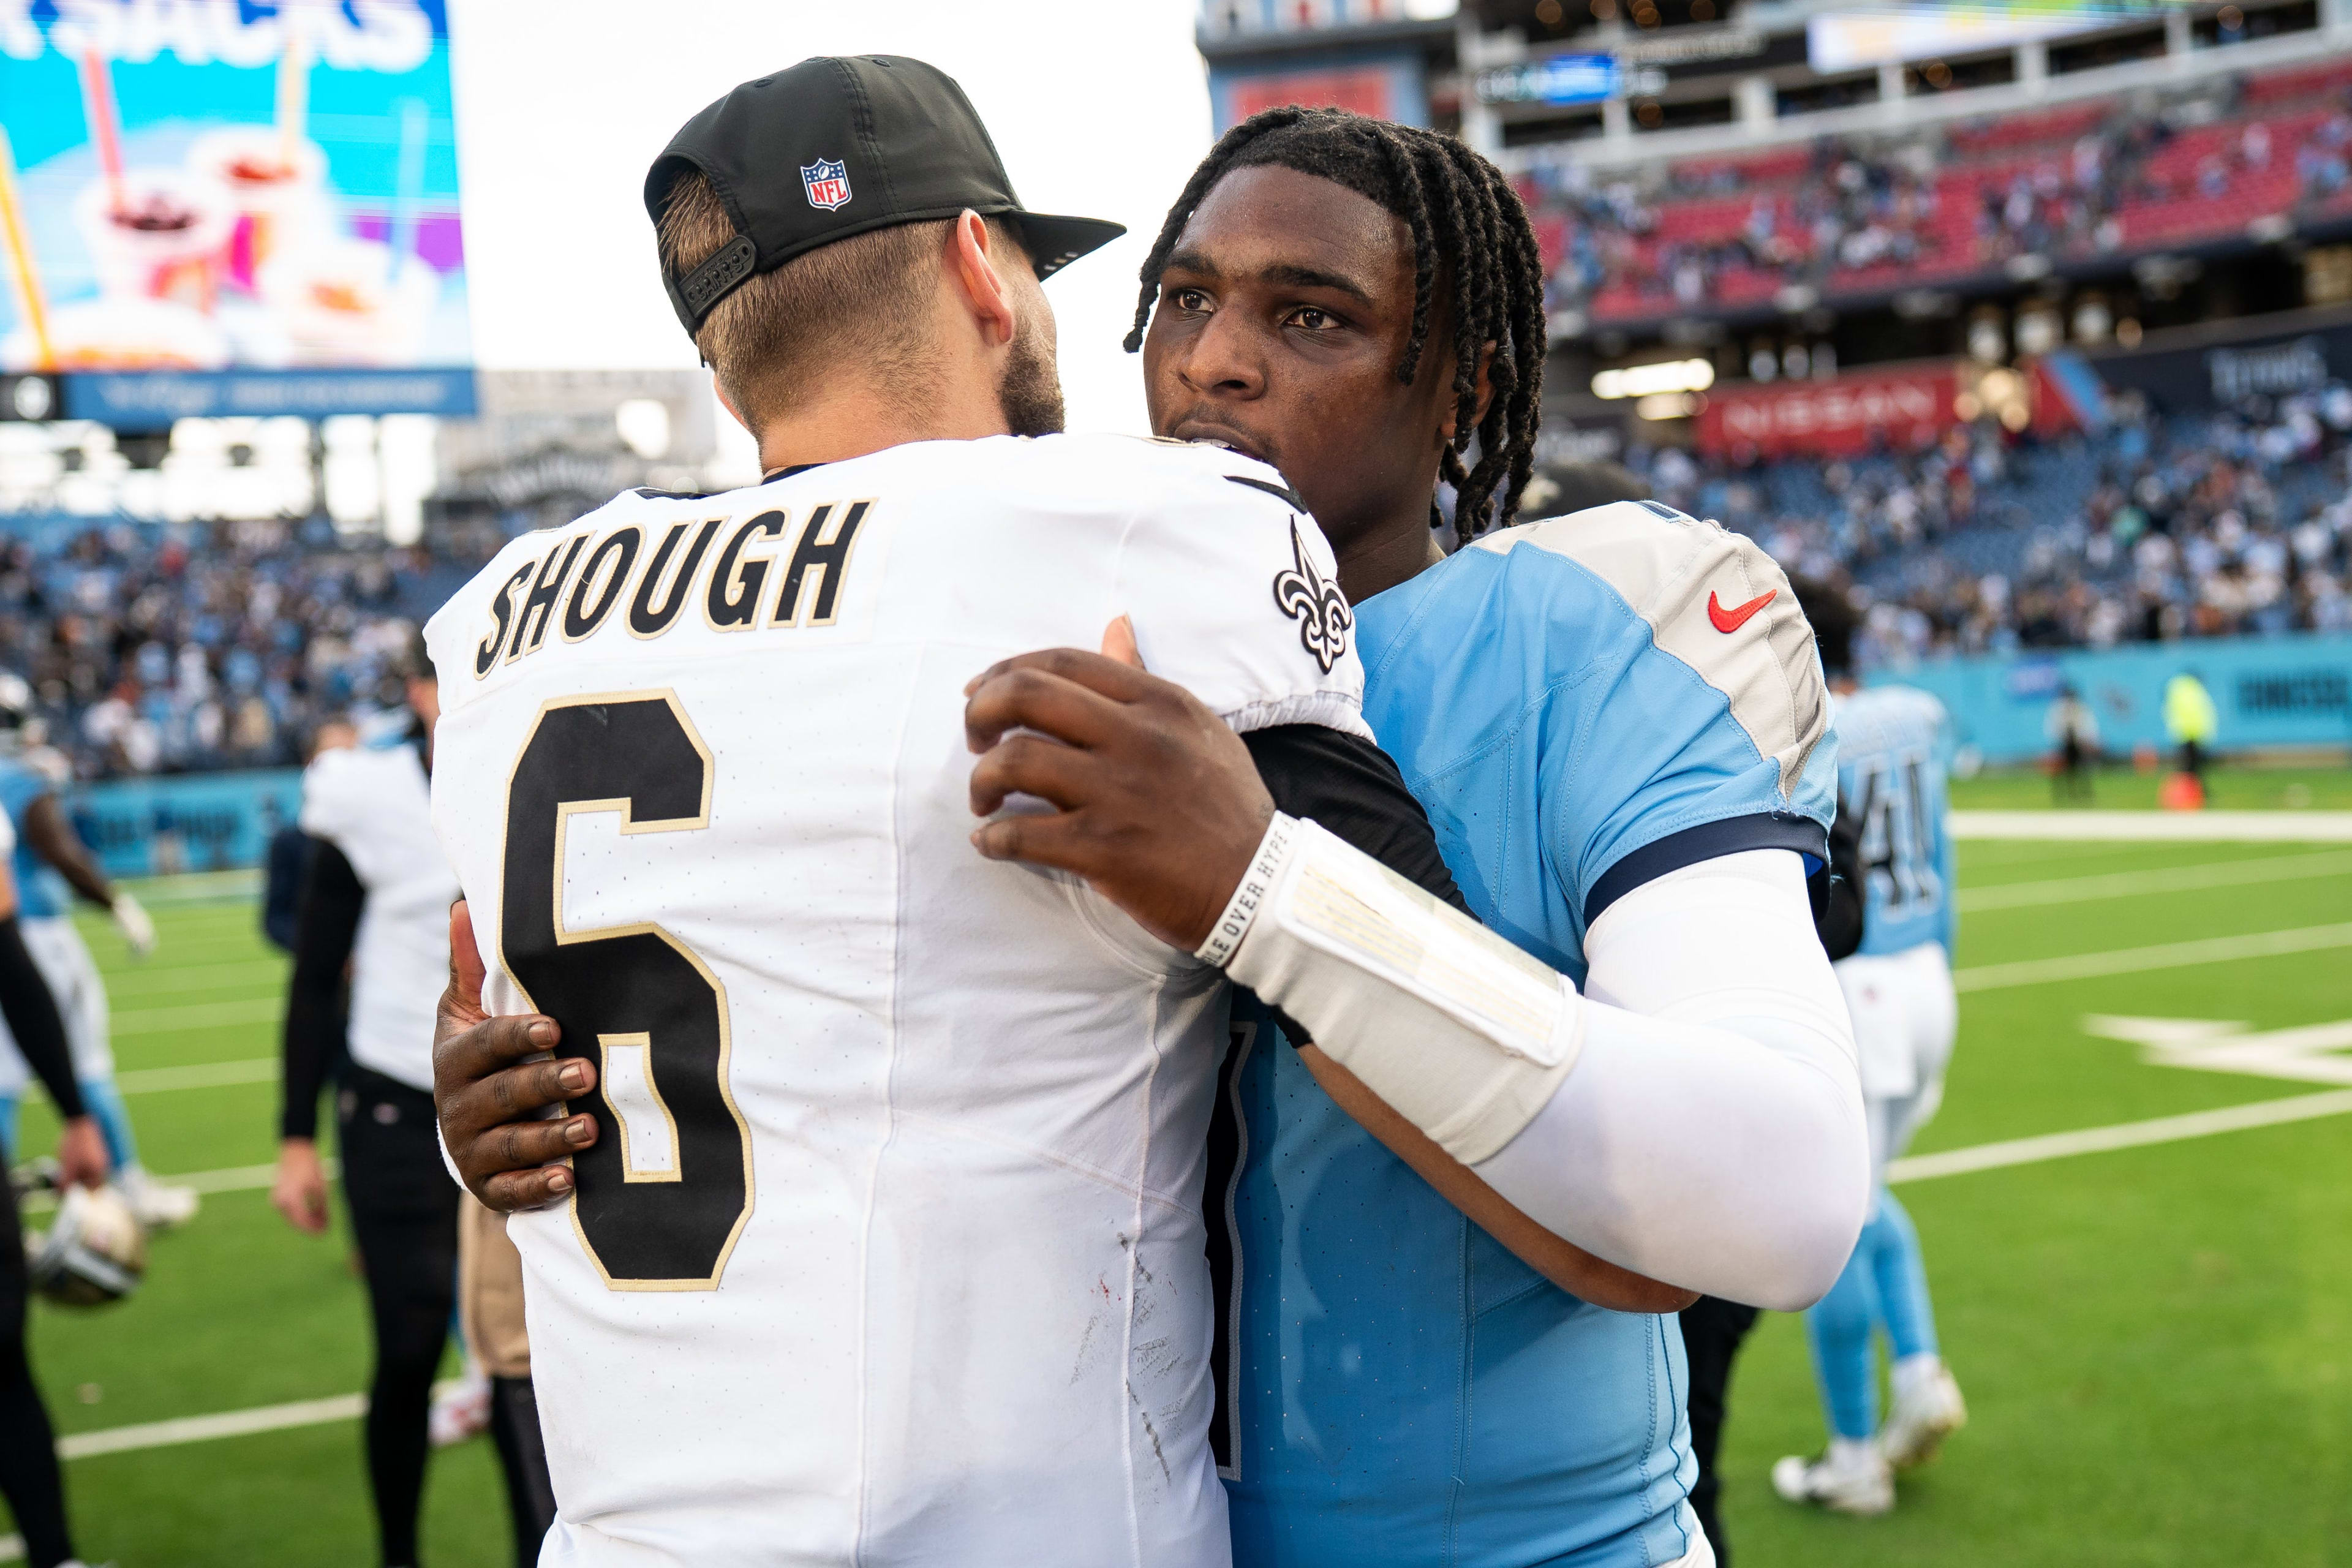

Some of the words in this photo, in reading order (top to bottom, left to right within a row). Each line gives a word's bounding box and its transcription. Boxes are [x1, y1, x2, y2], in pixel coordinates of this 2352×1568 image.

[811, 179, 847, 203] NFL
[472, 497, 878, 680] SHOUGH
[1223, 881, 1265, 937] OVER
[1257, 831, 1288, 878] HYPE
[496, 687, 756, 1292] 6
